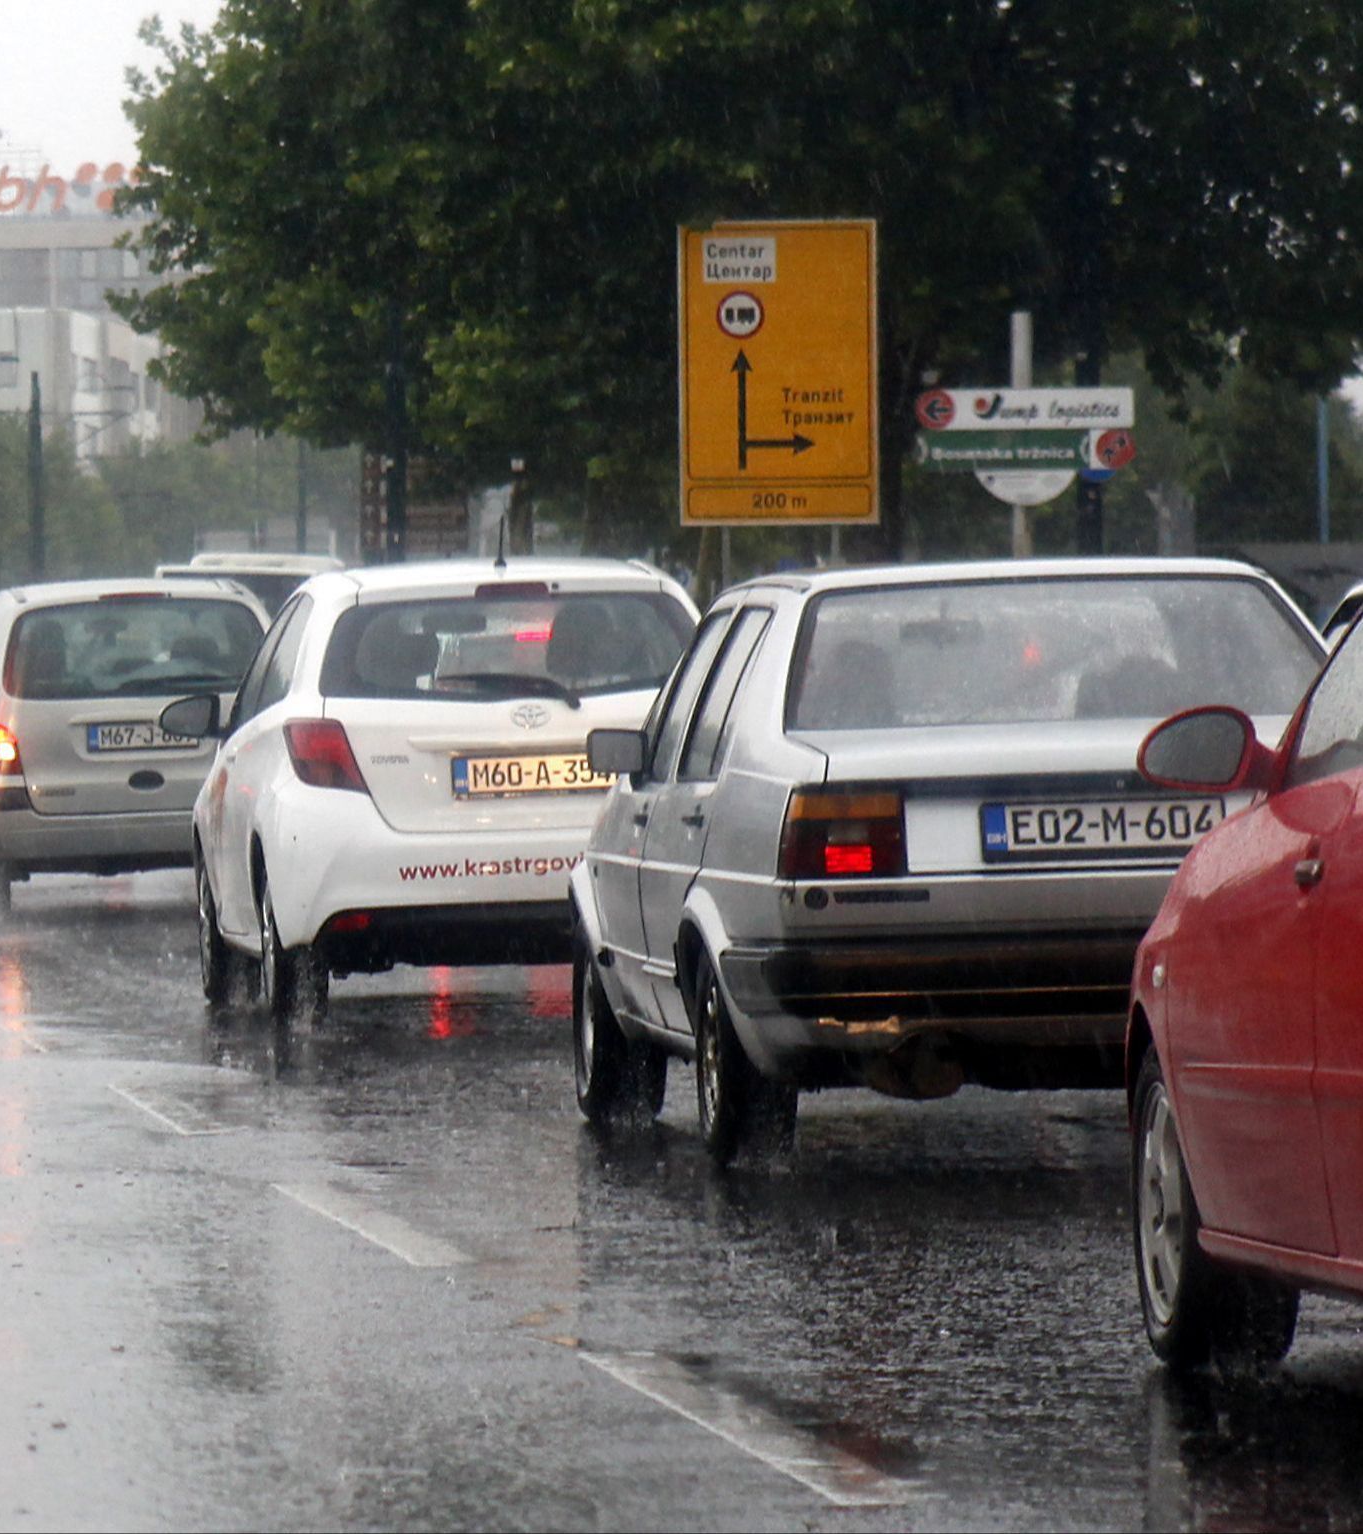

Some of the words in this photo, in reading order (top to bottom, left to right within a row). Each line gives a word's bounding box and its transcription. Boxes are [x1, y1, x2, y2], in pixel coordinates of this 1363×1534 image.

[707, 244, 765, 259] Centar
[707, 263, 772, 282] Центар
[782, 388, 844, 402] Tranzit
[782, 409, 854, 428] Транзит
[752, 494, 786, 509] 200
[791, 496, 807, 509] m
[1011, 804, 1213, 844] E02-M-604
